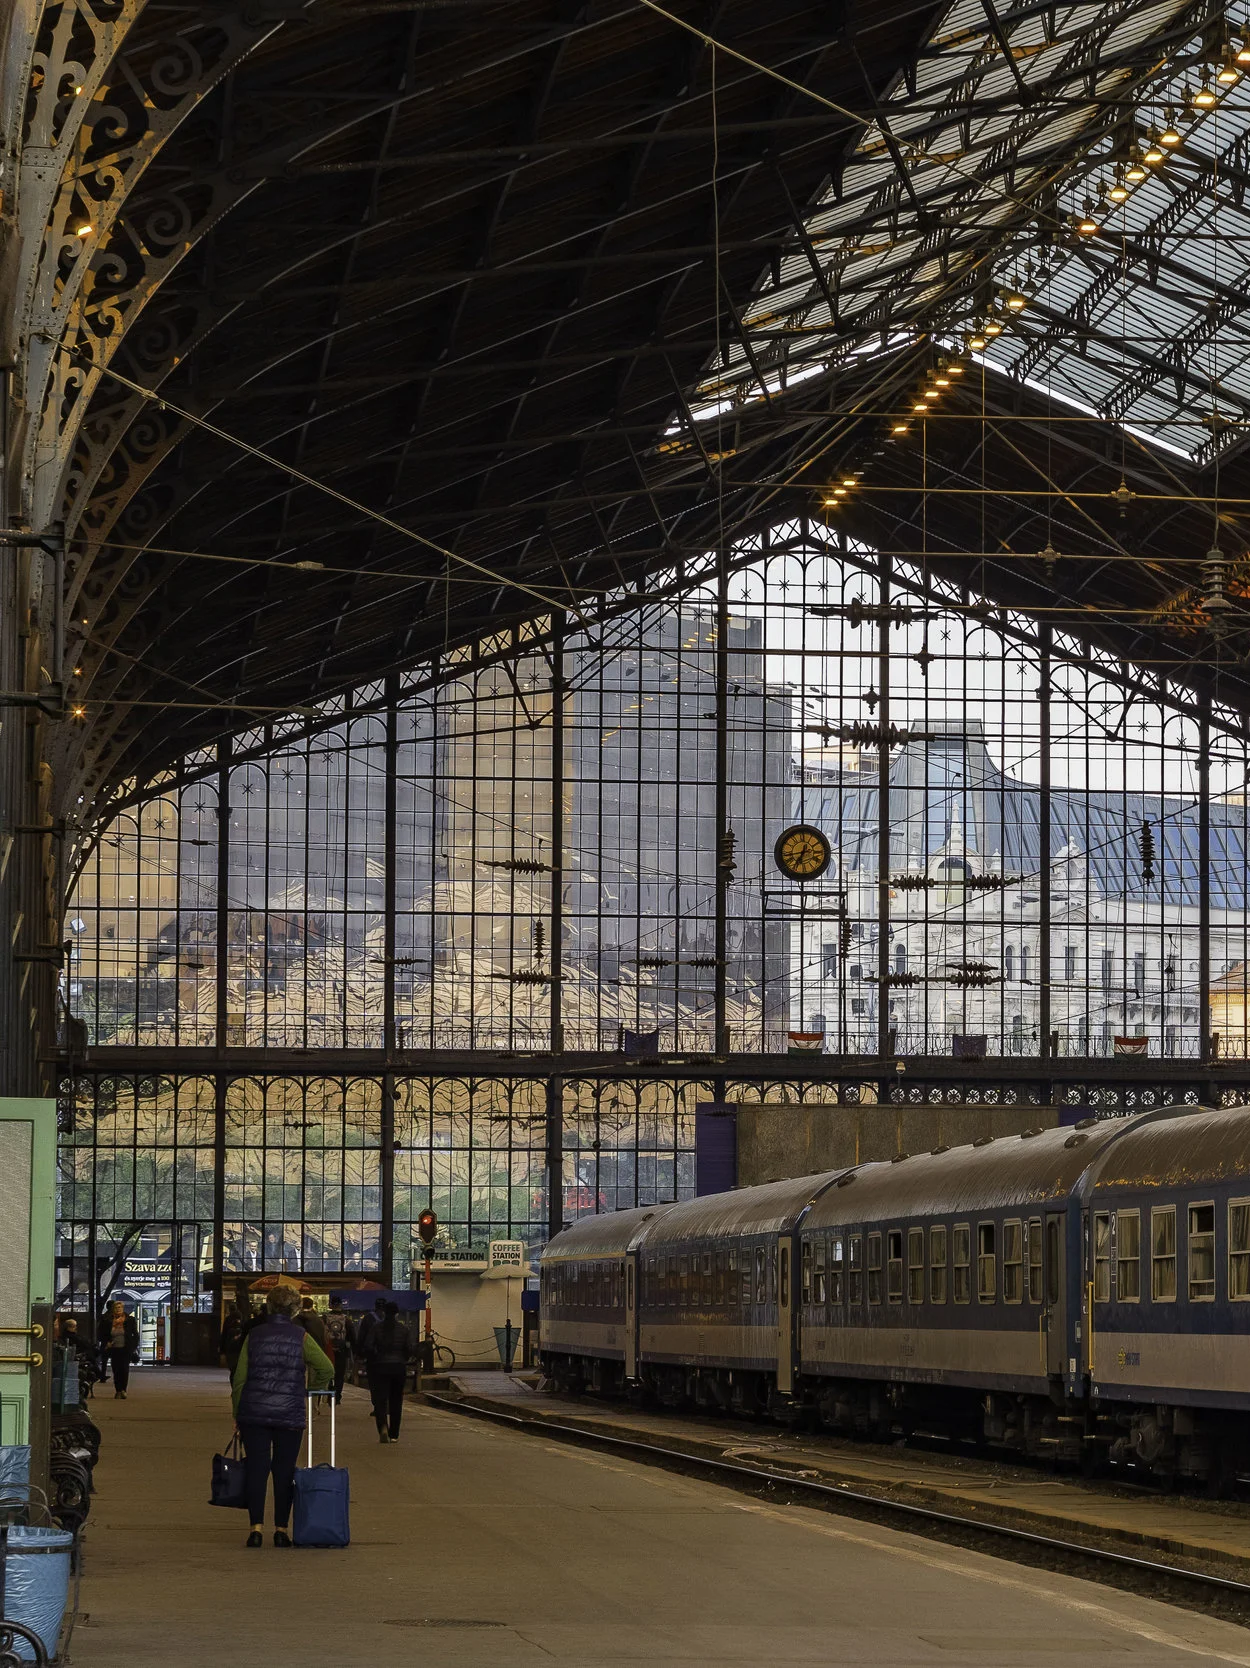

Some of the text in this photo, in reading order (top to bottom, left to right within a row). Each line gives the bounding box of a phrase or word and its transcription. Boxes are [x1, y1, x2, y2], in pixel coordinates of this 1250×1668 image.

[1112, 1214, 1116, 1235] 2
[1024, 1223, 1028, 1241] 2
[492, 1244, 520, 1252] COFFEE
[451, 1252, 485, 1260] STATION
[492, 1252, 520, 1260] STATION
